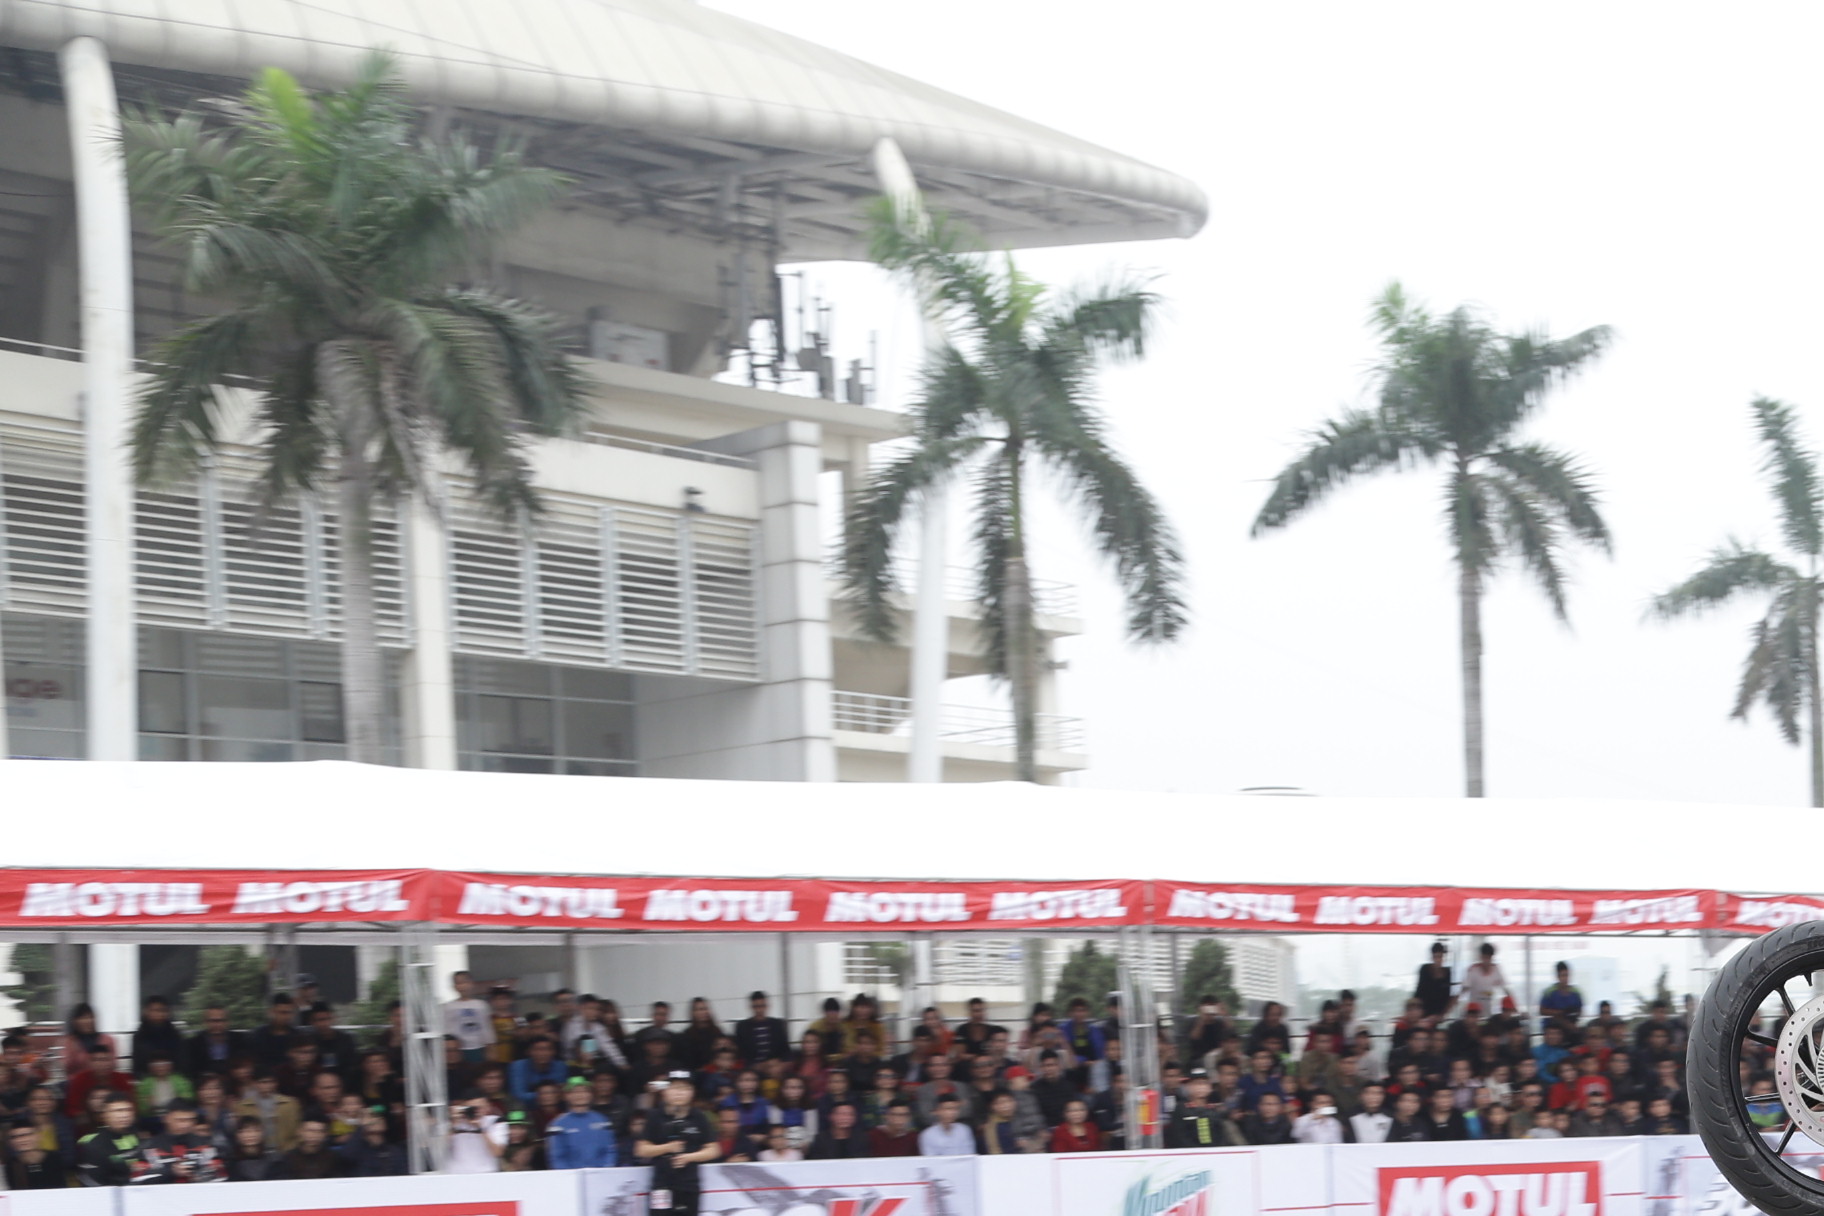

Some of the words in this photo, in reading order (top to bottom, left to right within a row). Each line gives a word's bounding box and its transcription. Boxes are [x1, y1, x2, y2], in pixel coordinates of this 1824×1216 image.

[18, 882, 210, 917] MOTUL
[231, 880, 408, 914] MOTUL
[458, 883, 625, 918] MOTUL
[642, 889, 799, 922] MOTUL
[823, 891, 972, 922] MOTUL
[988, 889, 1127, 919] MOTUL
[1167, 889, 1299, 923] MOTUL
[1313, 896, 1440, 926] MOTUL
[1458, 897, 1578, 926] MOTUL
